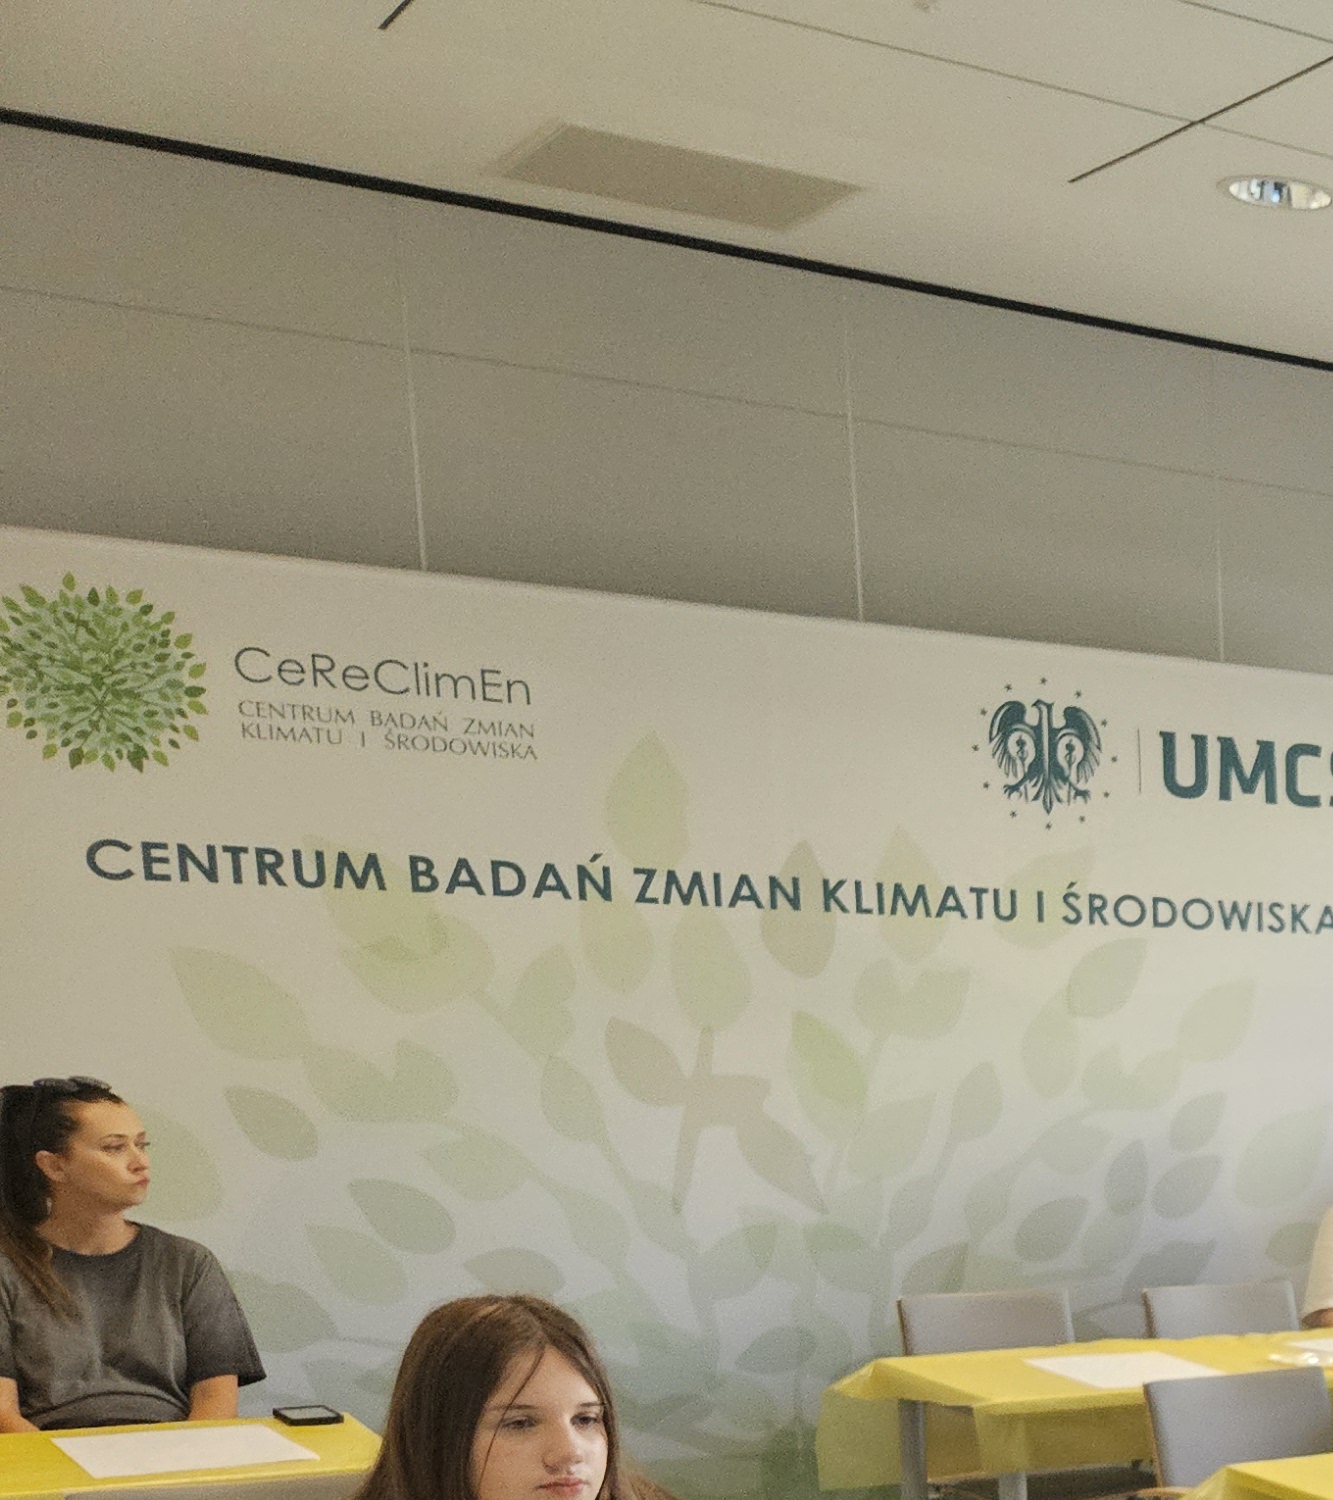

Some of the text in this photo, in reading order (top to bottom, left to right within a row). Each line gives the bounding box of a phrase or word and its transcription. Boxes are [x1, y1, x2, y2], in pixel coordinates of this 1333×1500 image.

[234, 647, 532, 706] CeReClimEn
[238, 699, 535, 739] CENTRUM BADAŃ ZMIAN
[240, 721, 538, 761] KLIMATU I ŚRODOWISKA
[85, 838, 388, 893] CENTRUM
[408, 852, 613, 903] BADAŃ
[632, 866, 802, 911] ZMIAN
[821, 877, 1018, 923] KLIMATU
[1036, 890, 1045, 924] I
